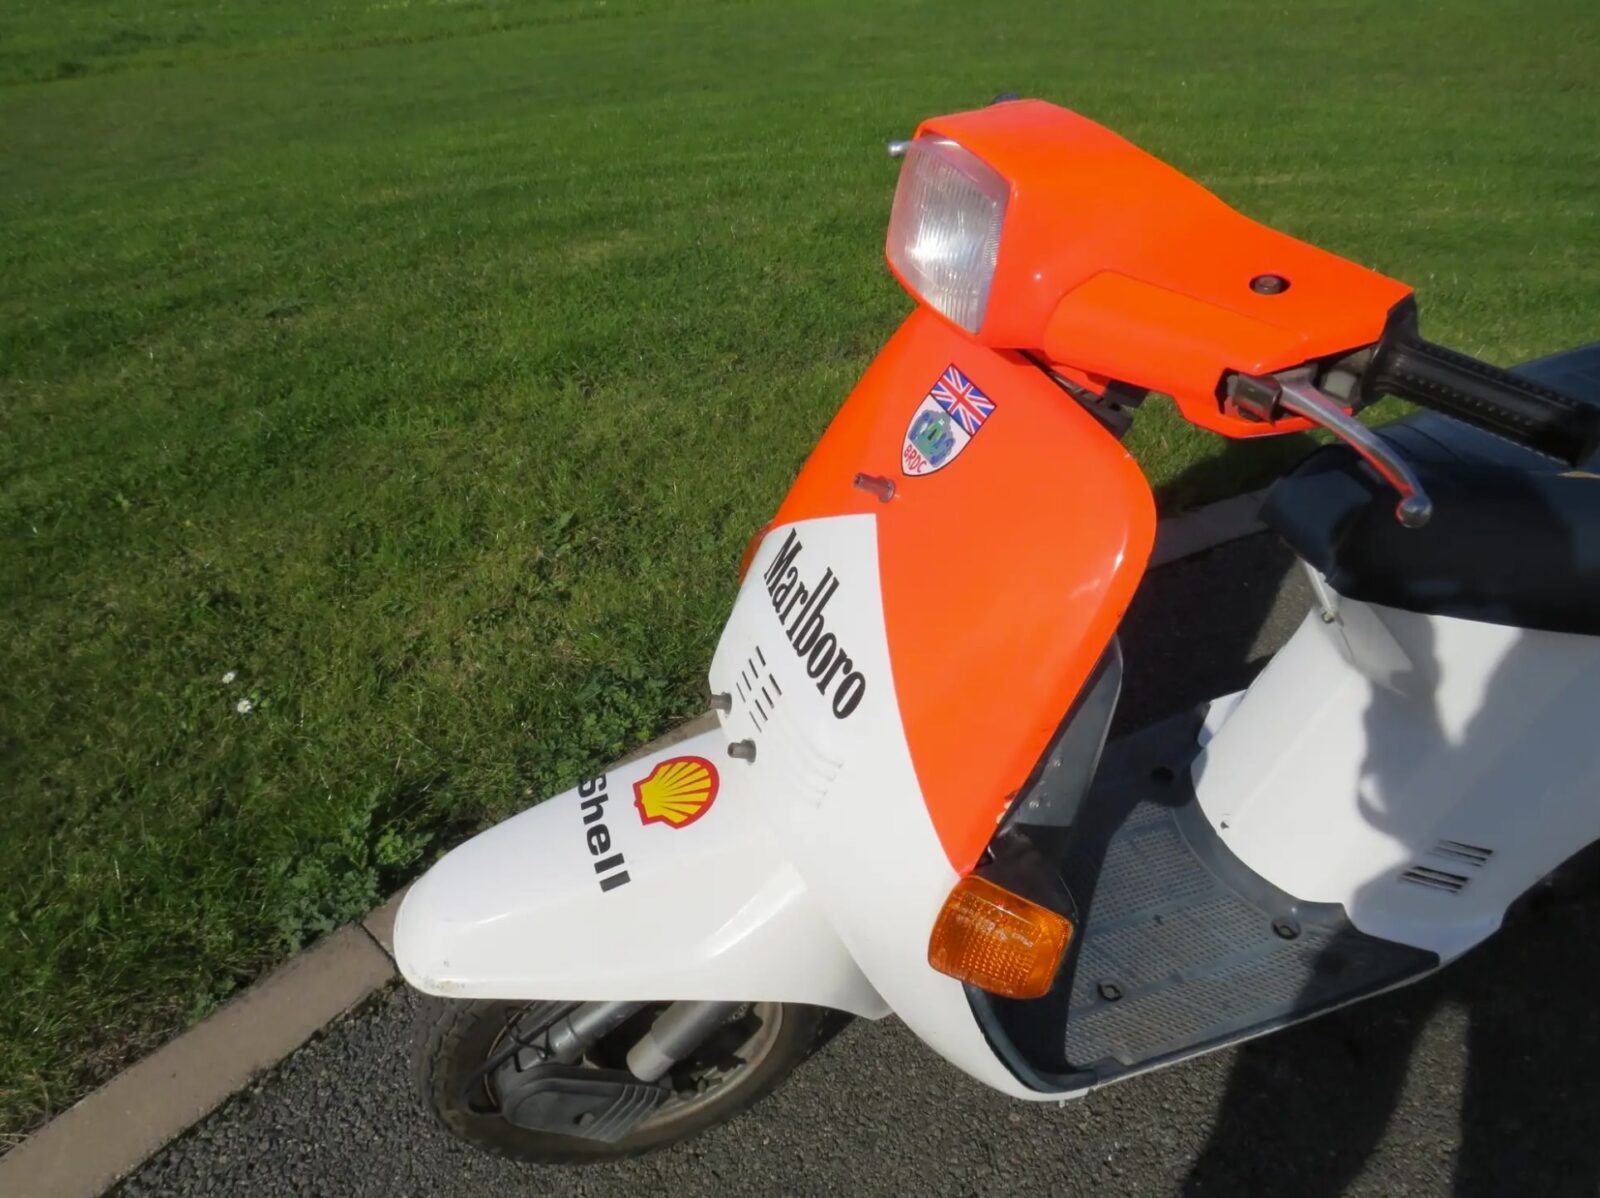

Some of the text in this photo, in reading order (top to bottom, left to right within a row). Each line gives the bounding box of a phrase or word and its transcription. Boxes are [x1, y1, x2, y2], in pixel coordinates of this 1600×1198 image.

[904, 444, 927, 473] BRDC
[764, 528, 866, 719] Marlboro
[578, 773, 631, 892] Shell
